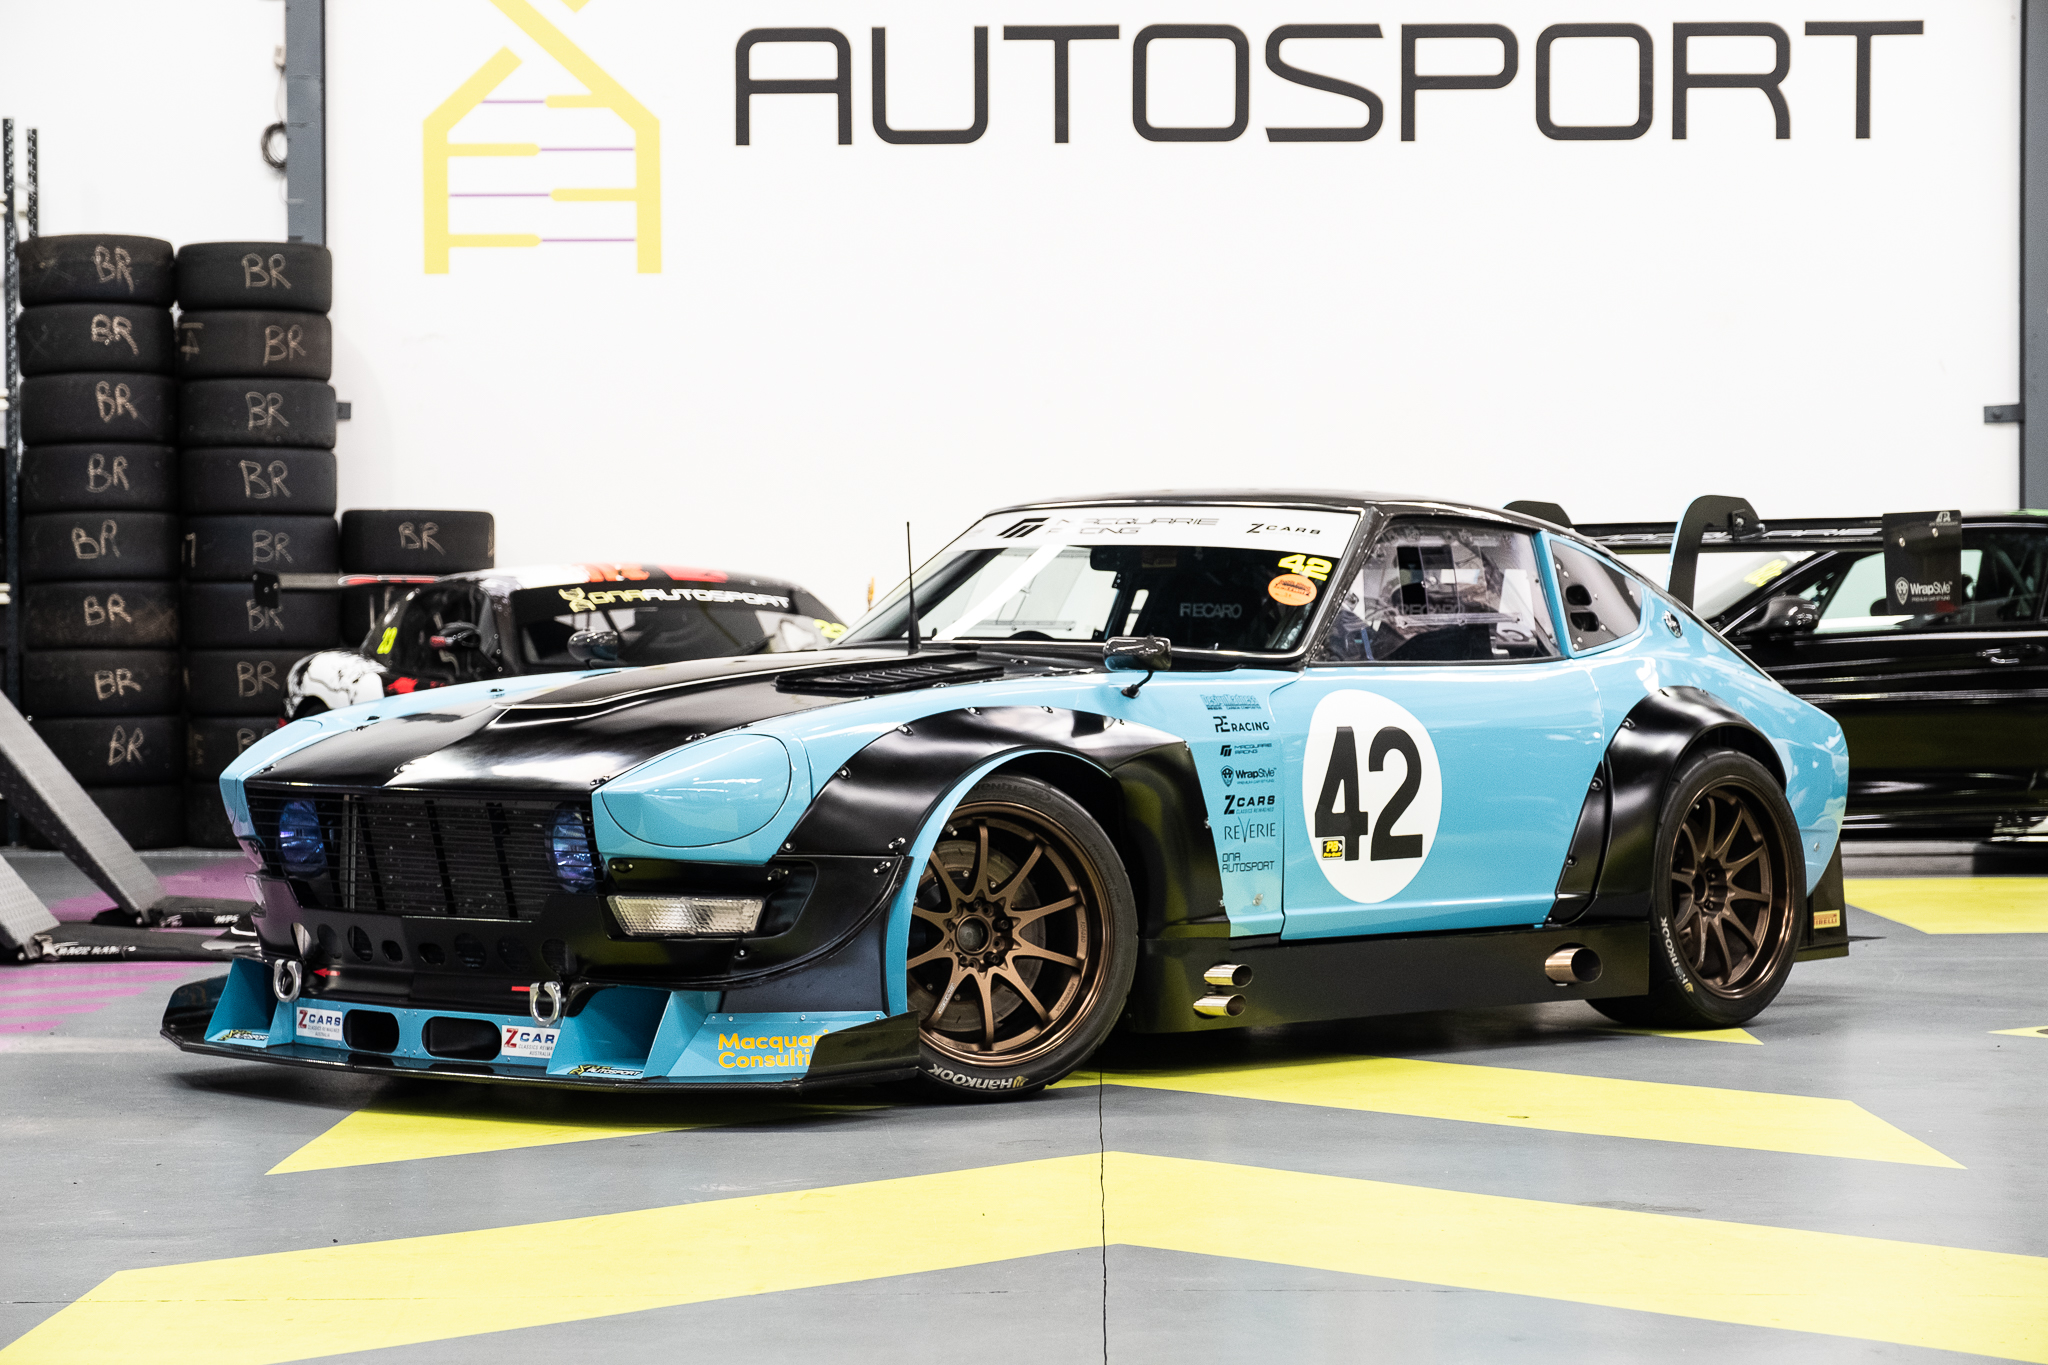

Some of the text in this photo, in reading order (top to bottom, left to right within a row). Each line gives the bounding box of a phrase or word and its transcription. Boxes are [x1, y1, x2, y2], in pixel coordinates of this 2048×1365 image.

[735, 19, 1925, 146] AUTOSPORT
[94, 245, 134, 294] BR
[242, 253, 291, 289] BR
[91, 314, 139, 356] BR
[264, 325, 306, 366] BR
[96, 381, 139, 423] BR
[245, 391, 289, 430] BR
[87, 453, 129, 492] BR
[239, 460, 292, 499] BR
[71, 518, 120, 559] BR
[252, 529, 293, 566] BR
[399, 521, 446, 556] BR
[1047, 527, 1141, 535] RCING
[1278, 554, 1332, 581] 42
[1910, 581, 1951, 595] WrapStyle
[85, 593, 132, 626] BR
[1180, 603, 1242, 618] RECARO
[95, 667, 141, 700] BR
[237, 660, 279, 697] BR
[1231, 721, 1270, 732] RACING
[108, 725, 145, 766] BR
[1235, 767, 1275, 780] WrapStyle
[1237, 795, 1275, 807] CARS
[1315, 725, 1424, 862] 42
[1224, 816, 1276, 843] REVERIE
[1222, 852, 1240, 862] DNA
[1222, 860, 1275, 873] AUTOSPORT
[1814, 915, 1837, 925] IRELLI
[309, 1014, 341, 1027] CARS
[504, 1028, 555, 1048] Z CAR
[718, 1029, 828, 1053] Macquar
